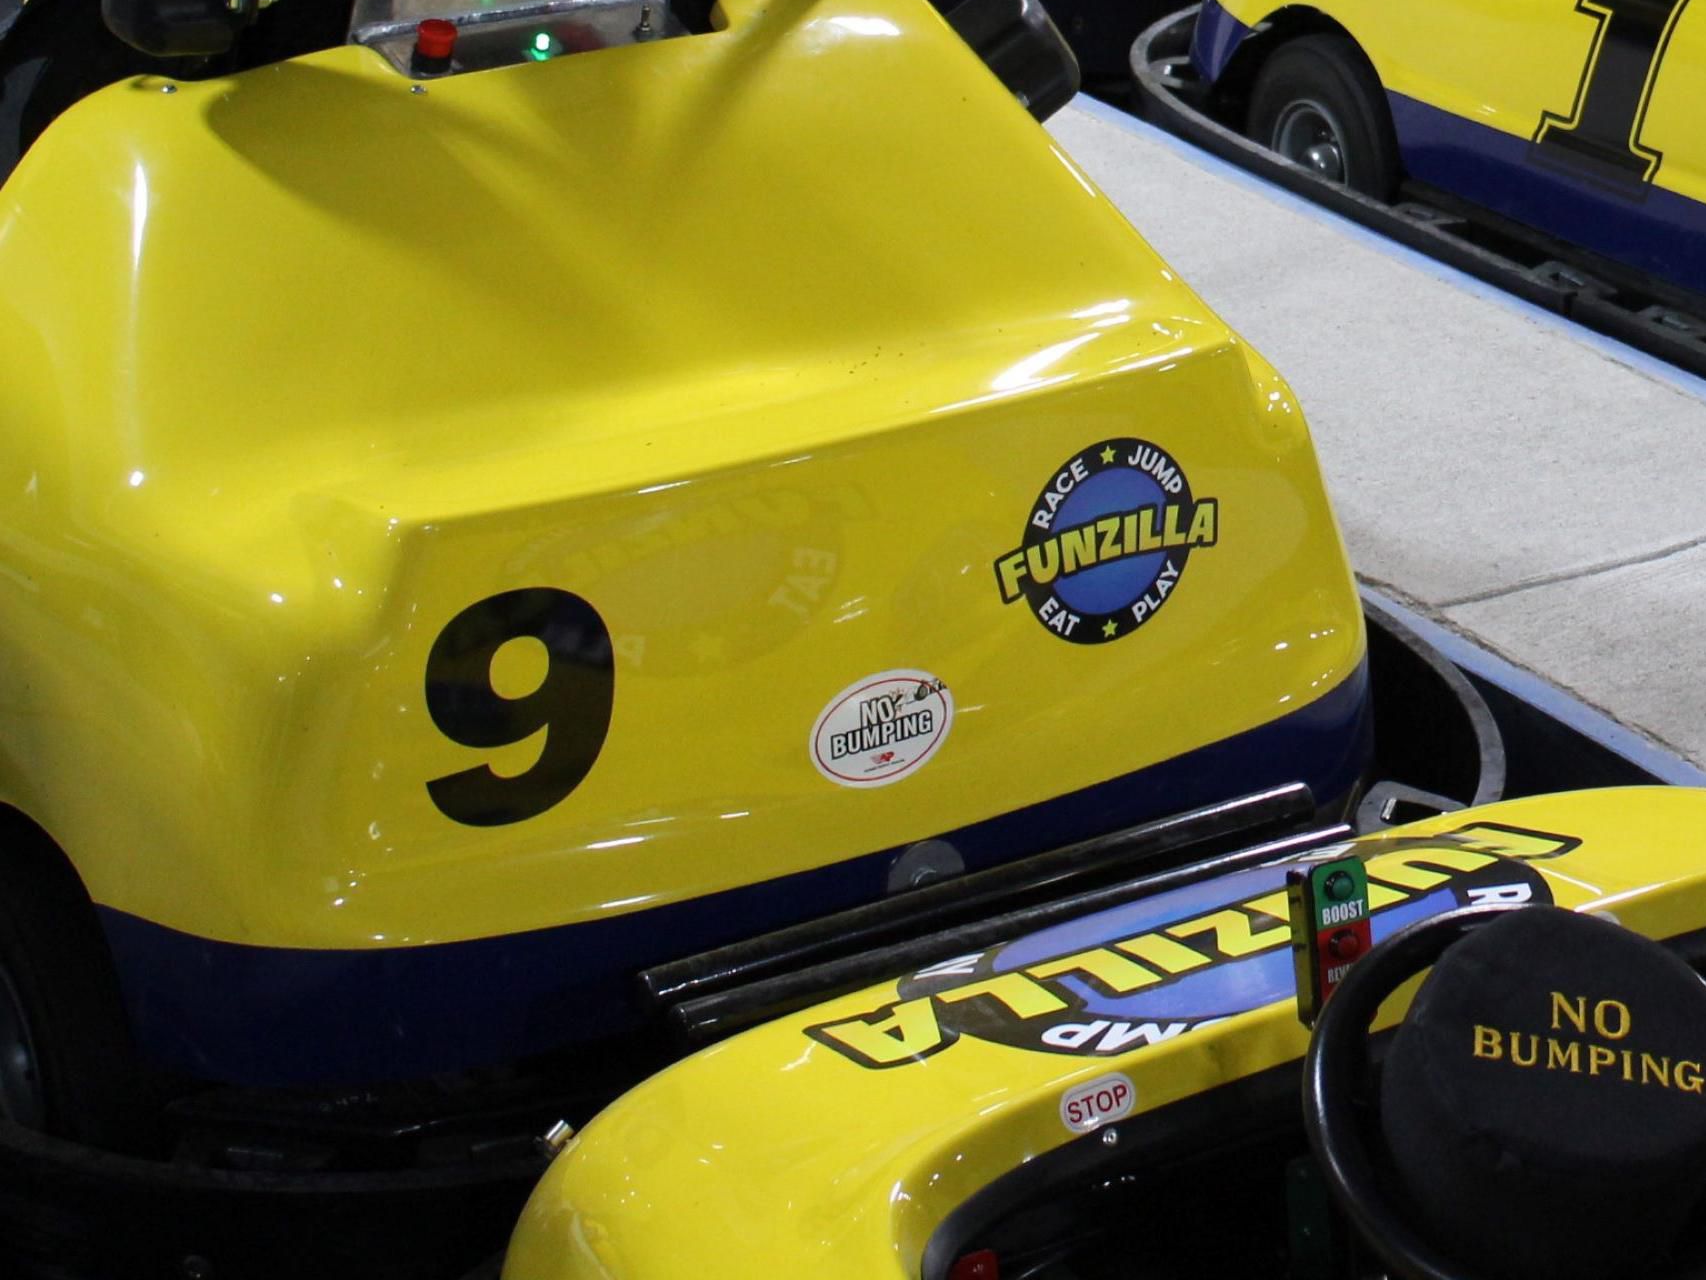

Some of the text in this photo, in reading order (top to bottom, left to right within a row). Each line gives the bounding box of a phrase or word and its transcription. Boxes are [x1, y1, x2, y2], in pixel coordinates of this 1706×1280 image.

[1032, 458, 1089, 530] RACE
[1128, 445, 1183, 495] JUMP
[995, 499, 1217, 603] FUNZILLA
[1038, 596, 1081, 636] EAT
[1132, 560, 1179, 623] PLAY
[425, 586, 615, 828] 9
[860, 694, 896, 728] NO
[830, 709, 933, 760] BUMPING
[1322, 898, 1365, 926] BOOST
[1550, 991, 1631, 1040] NO
[1473, 1024, 1705, 1094] BUMPING
[1067, 1083, 1129, 1124] STOP
